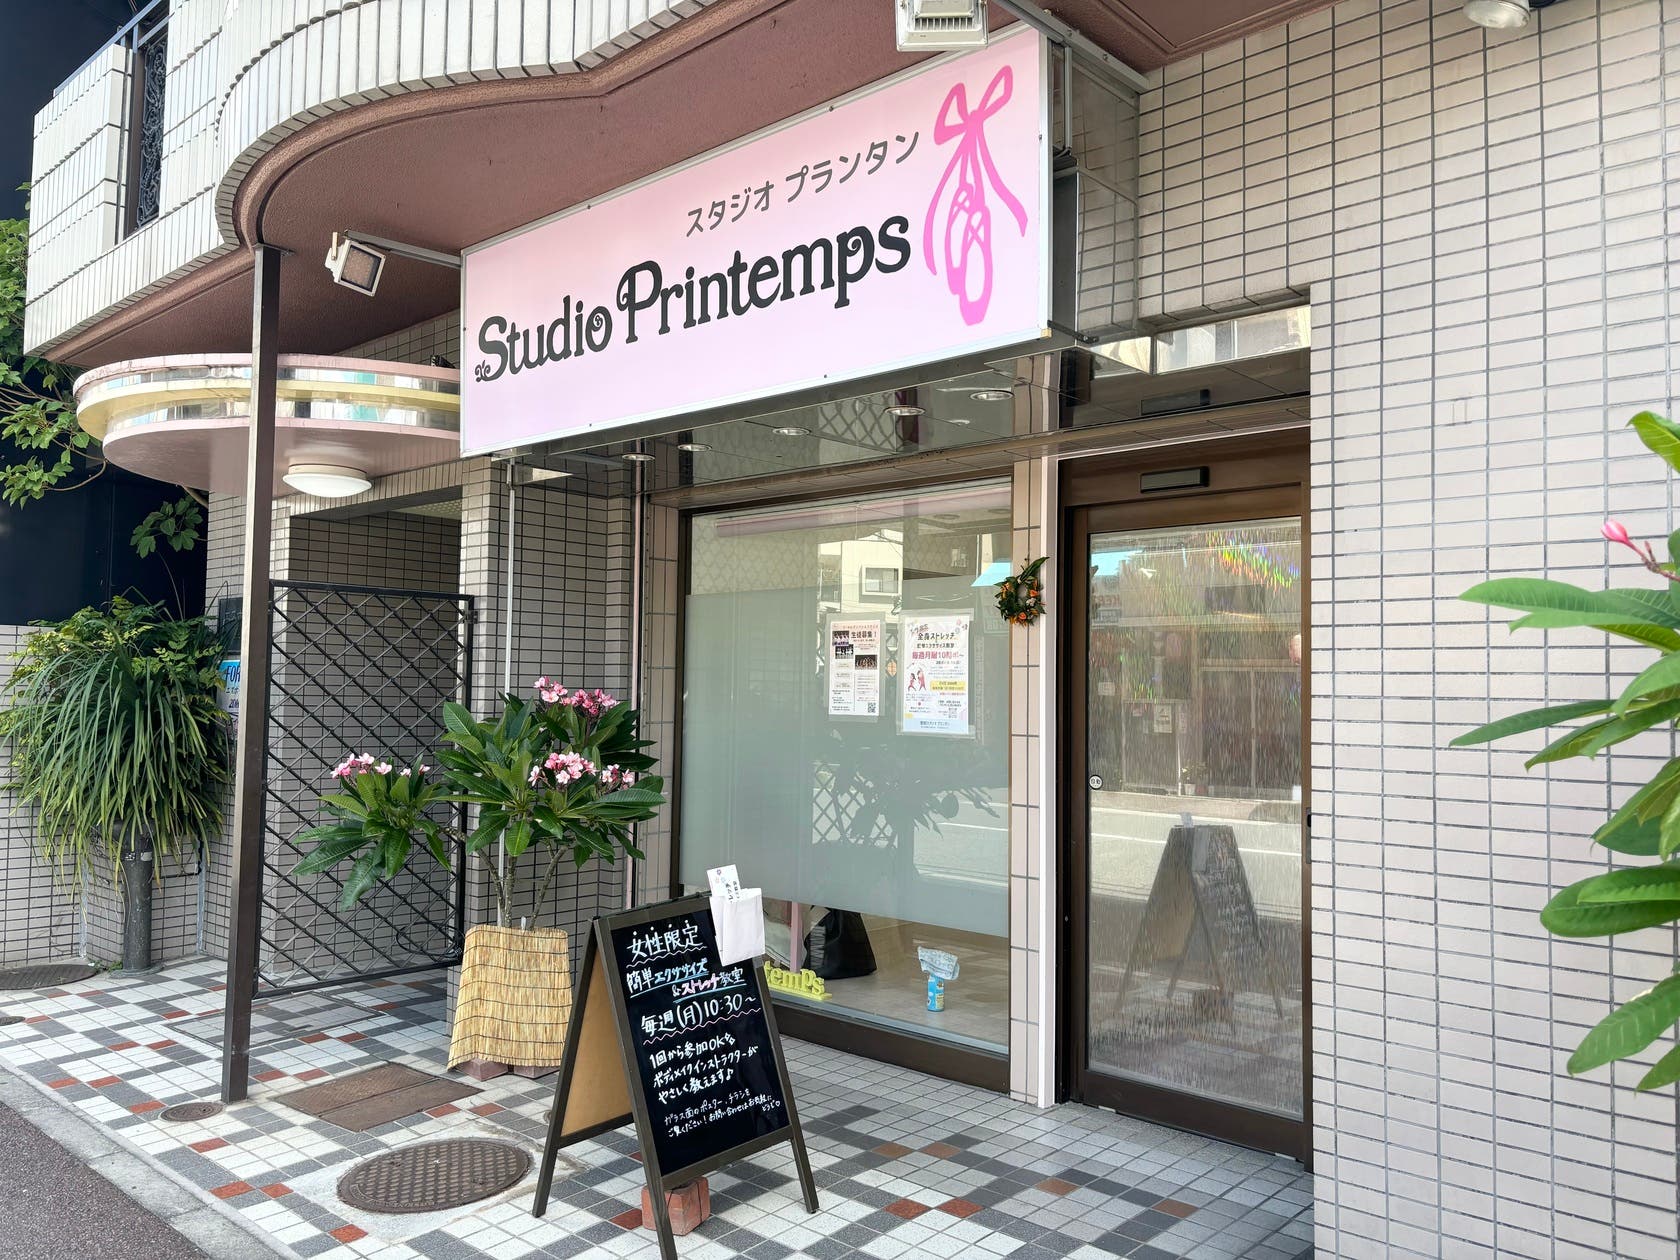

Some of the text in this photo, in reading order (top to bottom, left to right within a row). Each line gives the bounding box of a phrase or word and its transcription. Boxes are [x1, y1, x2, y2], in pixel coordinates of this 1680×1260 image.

[686, 131, 920, 237] スタジオ プランタン
[474, 215, 912, 383] Studio Printemps
[626, 921, 704, 963] 女性限定
[626, 957, 709, 994] 簡単エクササイズ
